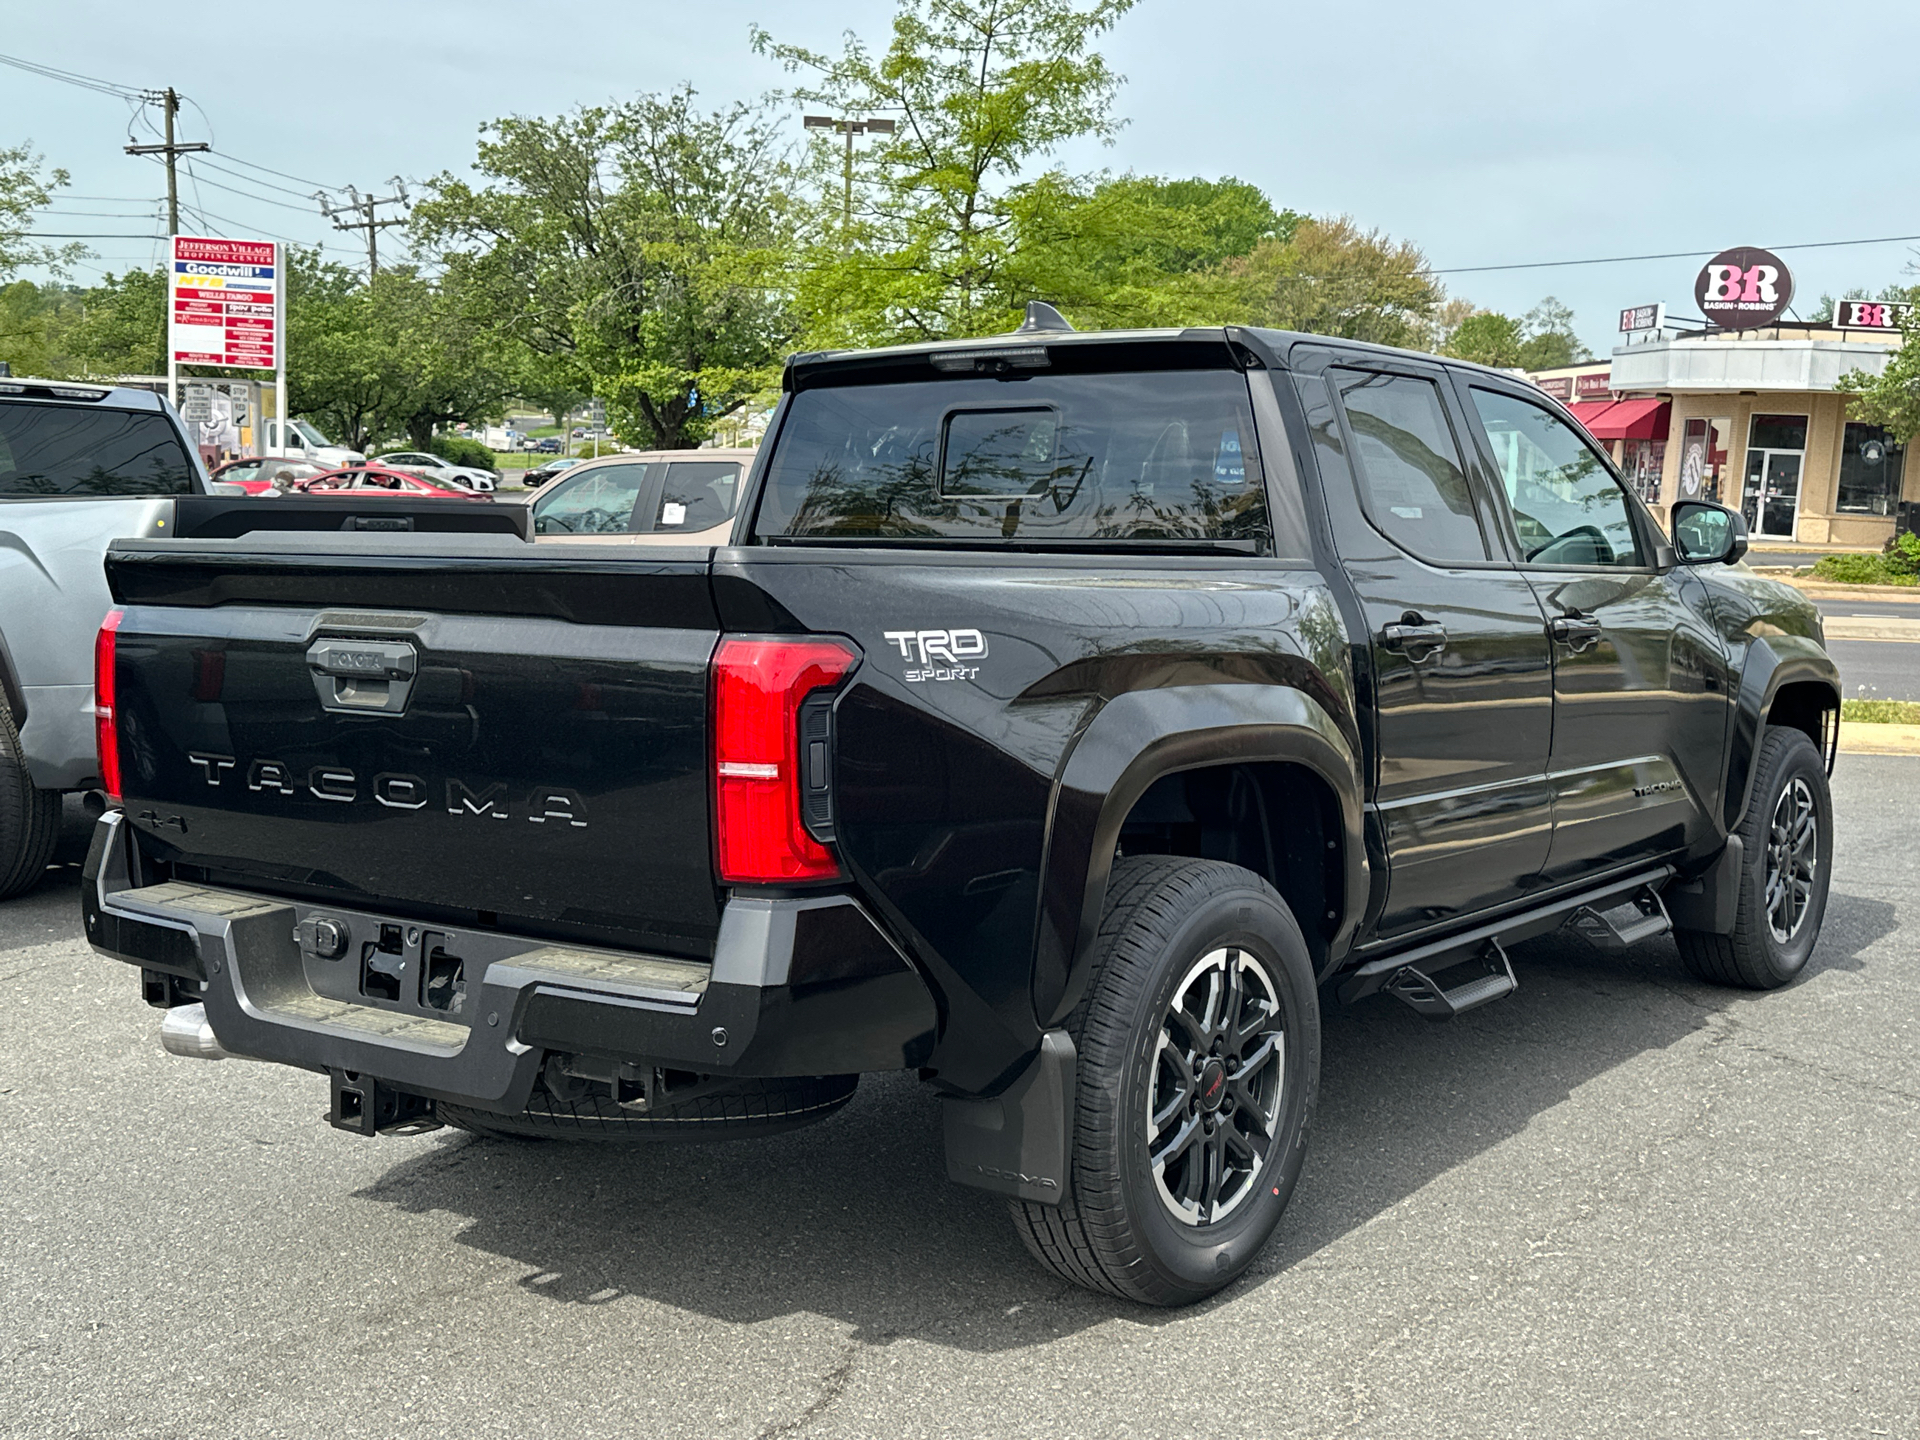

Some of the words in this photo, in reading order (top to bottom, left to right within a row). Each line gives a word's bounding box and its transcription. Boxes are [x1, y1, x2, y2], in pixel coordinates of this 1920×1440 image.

[231, 243, 272, 256] VILLAGE
[177, 251, 229, 260] SHOPPING
[232, 255, 273, 264] CENTER
[186, 263, 253, 277] Goodwill
[178, 275, 224, 288] NTB
[198, 290, 226, 300] WELLS
[226, 292, 253, 302] FARGO
[233, 387, 247, 395] STOP
[884, 629, 986, 665] TRD
[331, 652, 381, 668] TOYOTA
[904, 667, 980, 682] SPORT
[189, 751, 588, 827] TACOMA
